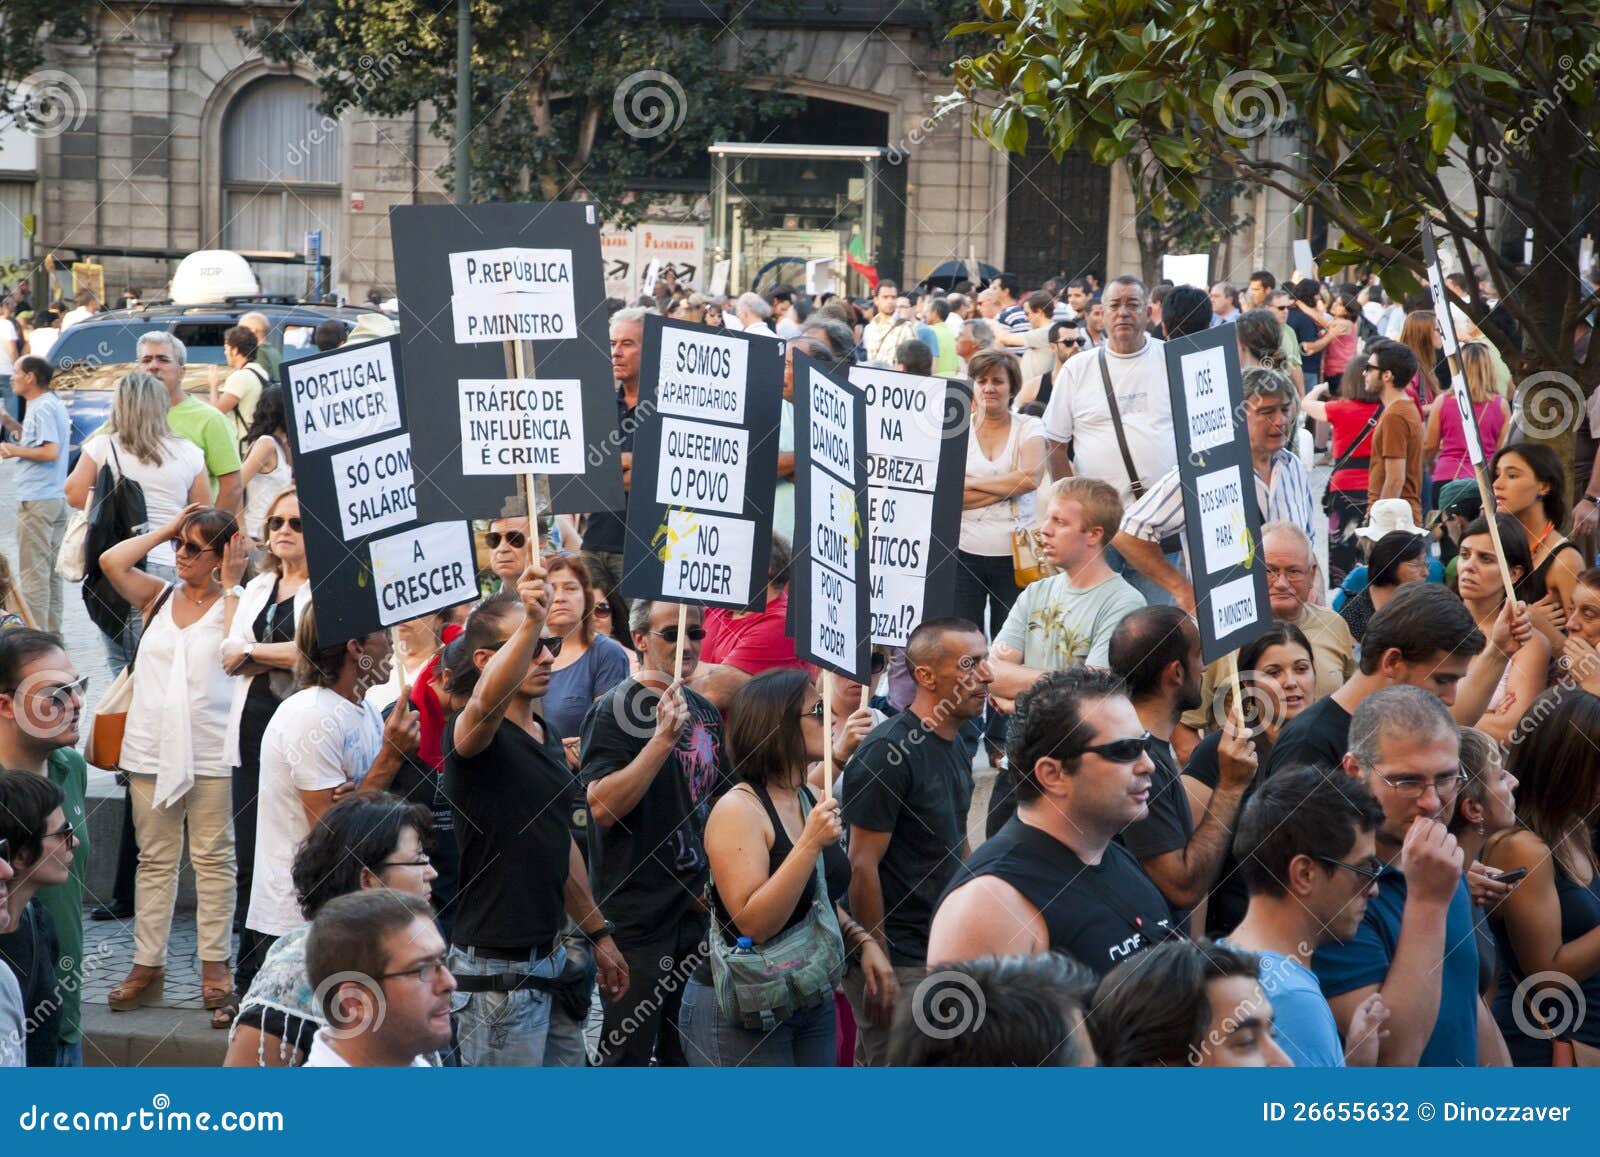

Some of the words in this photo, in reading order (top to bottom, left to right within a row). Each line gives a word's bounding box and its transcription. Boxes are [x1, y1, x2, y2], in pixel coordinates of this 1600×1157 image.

[466, 255, 569, 284] P.REPÚBLICA
[468, 313, 564, 336] P.MINISTRO
[676, 341, 731, 379] SOMOS
[294, 359, 387, 403] PORTUGAL
[662, 381, 737, 412] APARTIDÁRIOS
[865, 383, 877, 406] O
[882, 385, 927, 412] POVO
[304, 410, 317, 434] A
[320, 391, 388, 428] VENCER
[465, 384, 538, 412] TRÁFICO
[542, 390, 564, 411] DE
[813, 383, 847, 430] GESTÃO
[469, 412, 571, 440] INFLUÊNCIA
[880, 418, 903, 442] NA
[481, 443, 491, 465] É
[498, 447, 560, 465] CRIME
[668, 430, 739, 465] QUEREMOS
[812, 421, 850, 471] DANOSA
[347, 455, 370, 489] SÓ
[670, 466, 682, 496] O
[686, 468, 729, 503] POVO
[867, 455, 924, 485] OBREZA
[881, 499, 895, 524] OS
[413, 539, 425, 563] A
[697, 524, 719, 557] NO
[817, 523, 848, 569] CRIME
[871, 527, 921, 569] ÍTICOS
[382, 561, 466, 611] CRESCER
[679, 559, 732, 596] PODER
[821, 571, 843, 604] POVO
[827, 605, 838, 625] NO
[820, 623, 846, 658] PODER
